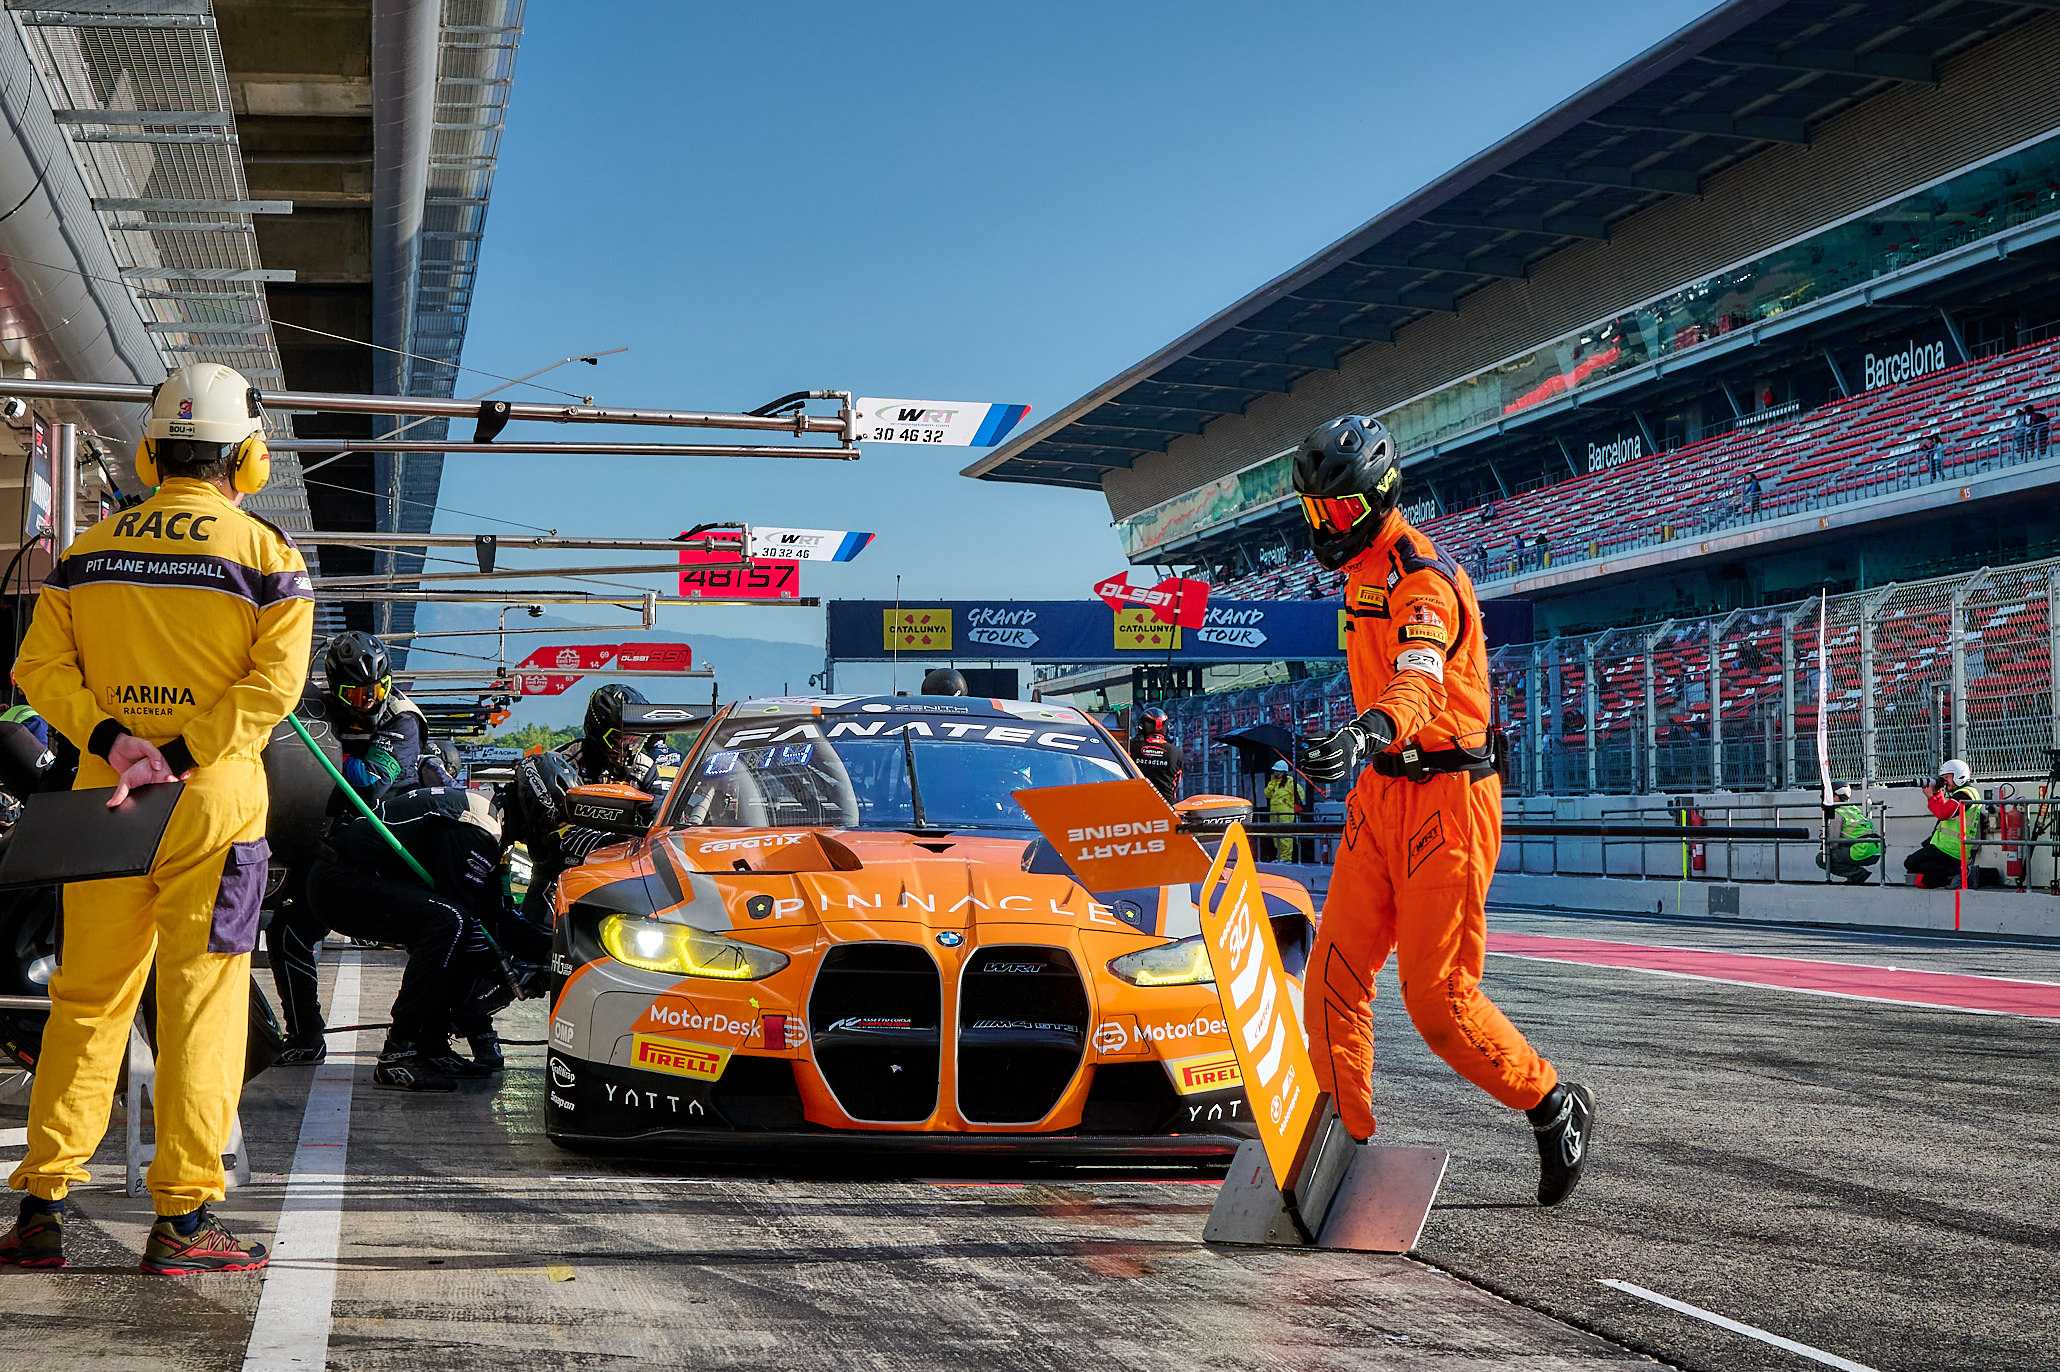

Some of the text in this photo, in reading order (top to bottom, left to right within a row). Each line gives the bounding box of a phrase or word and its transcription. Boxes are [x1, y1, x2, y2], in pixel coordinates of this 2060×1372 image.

[1865, 340, 1945, 390] Barcelona
[898, 408, 959, 423] WRT
[874, 427, 944, 443] 30 46 32
[1588, 432, 1641, 472] Barcelona
[113, 511, 218, 541] RACC
[781, 534, 825, 545] WRT
[762, 547, 810, 559] 30 32 46
[86, 558, 225, 579] PIT LANE MARSHALL
[967, 607, 1038, 626] GRAND
[889, 625, 947, 634] CATALUNYA
[976, 629, 1028, 645] TOUR
[1119, 625, 1176, 633] CATALUNYA
[1205, 629, 1257, 645] TOUR
[106, 685, 196, 706] MARINA
[123, 707, 173, 716] RACEWEAR
[724, 721, 1089, 751] FANATEC
[574, 804, 623, 821] WRT
[1067, 819, 1169, 842] ENGINE
[1077, 839, 1165, 861] START
[774, 893, 1118, 926] PINNACLE
[984, 962, 1047, 973] WRT
[650, 1004, 761, 1039] MotorDesk
[1133, 1018, 1228, 1043] MotorDes
[554, 1022, 574, 1044] OMP
[639, 1041, 721, 1074] PIRELLI
[1182, 1060, 1240, 1087] PIREL
[606, 1083, 704, 1115] YATTA
[1189, 1100, 1242, 1122] YAT
